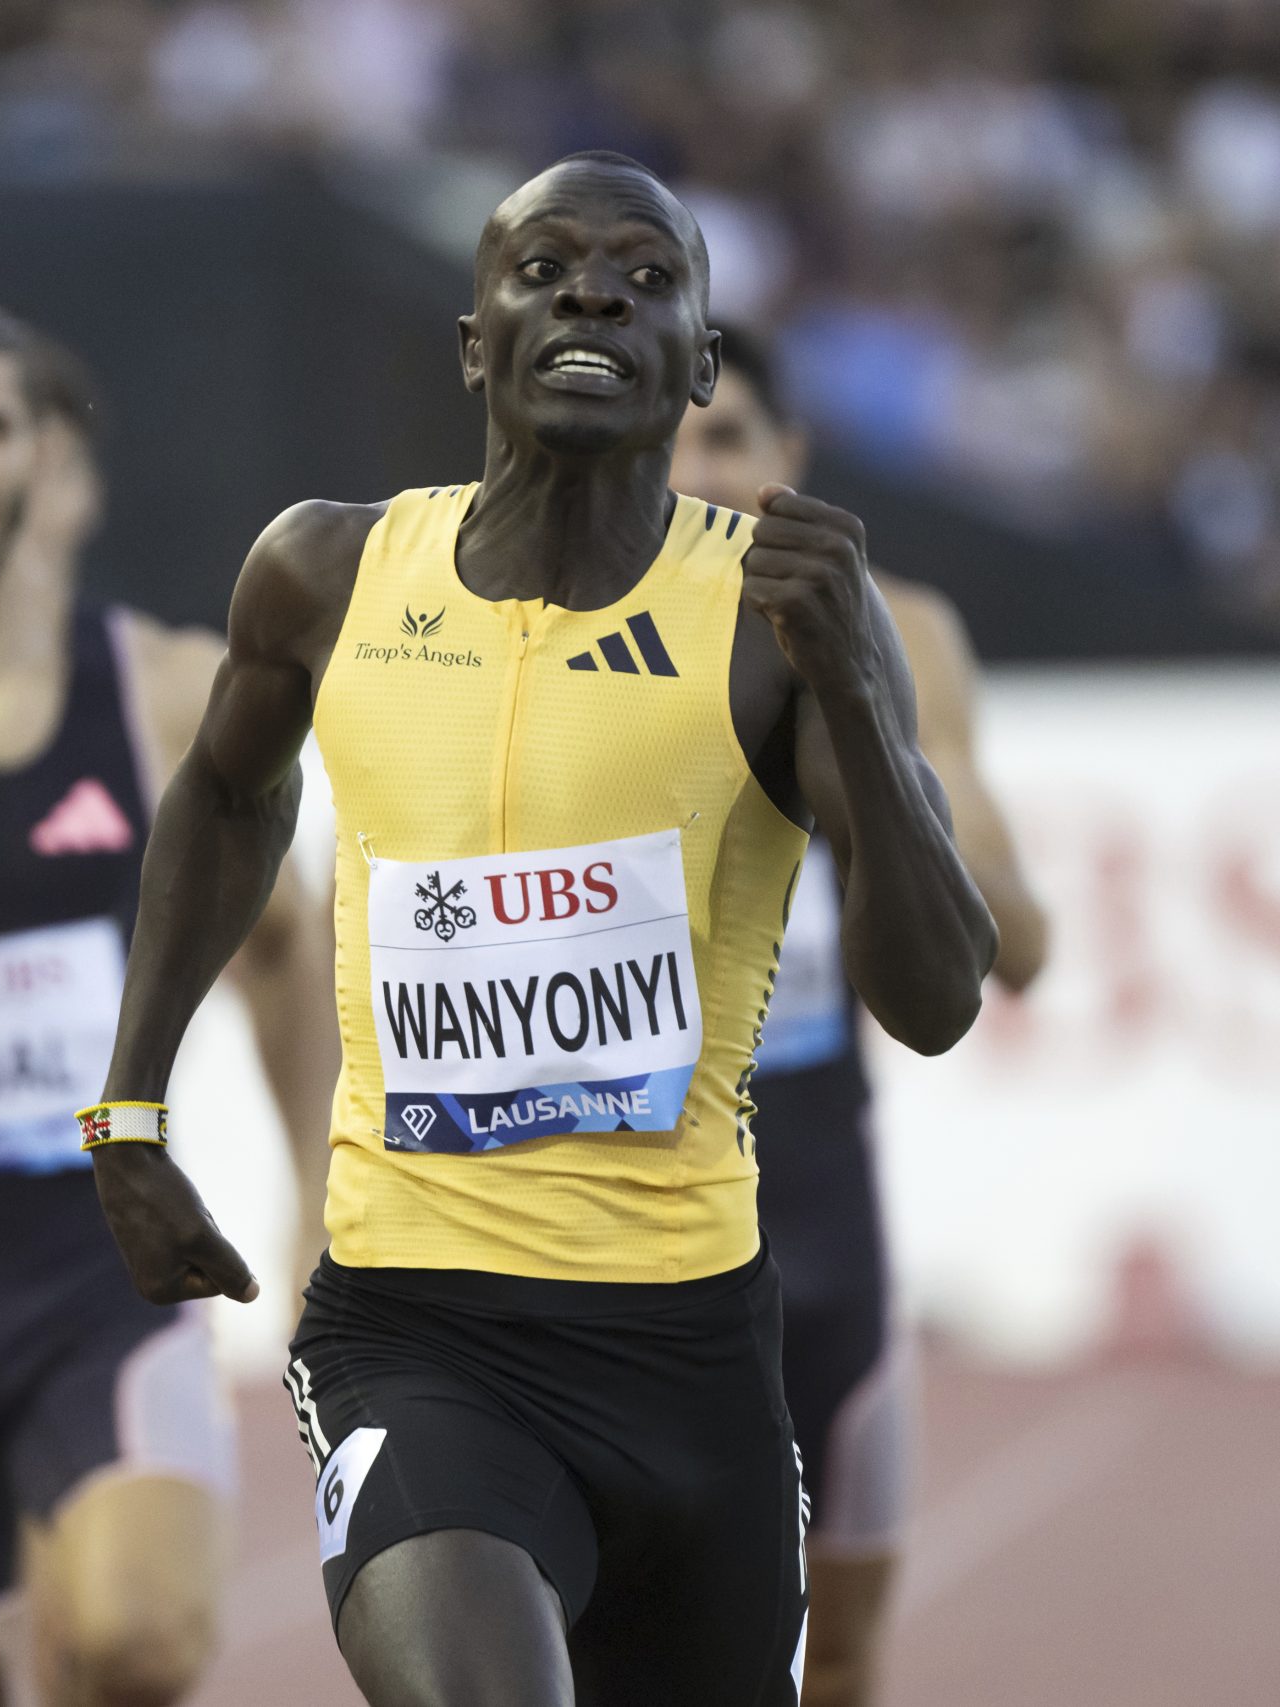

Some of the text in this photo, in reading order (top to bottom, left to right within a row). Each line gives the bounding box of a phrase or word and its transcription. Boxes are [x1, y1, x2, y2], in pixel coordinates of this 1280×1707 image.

[354, 642, 482, 667] Tirop's Angels
[484, 861, 619, 926] UBS
[382, 951, 688, 1061] WANYONYI
[468, 1088, 652, 1135] LAUSANNE
[323, 1463, 345, 1526] 6
